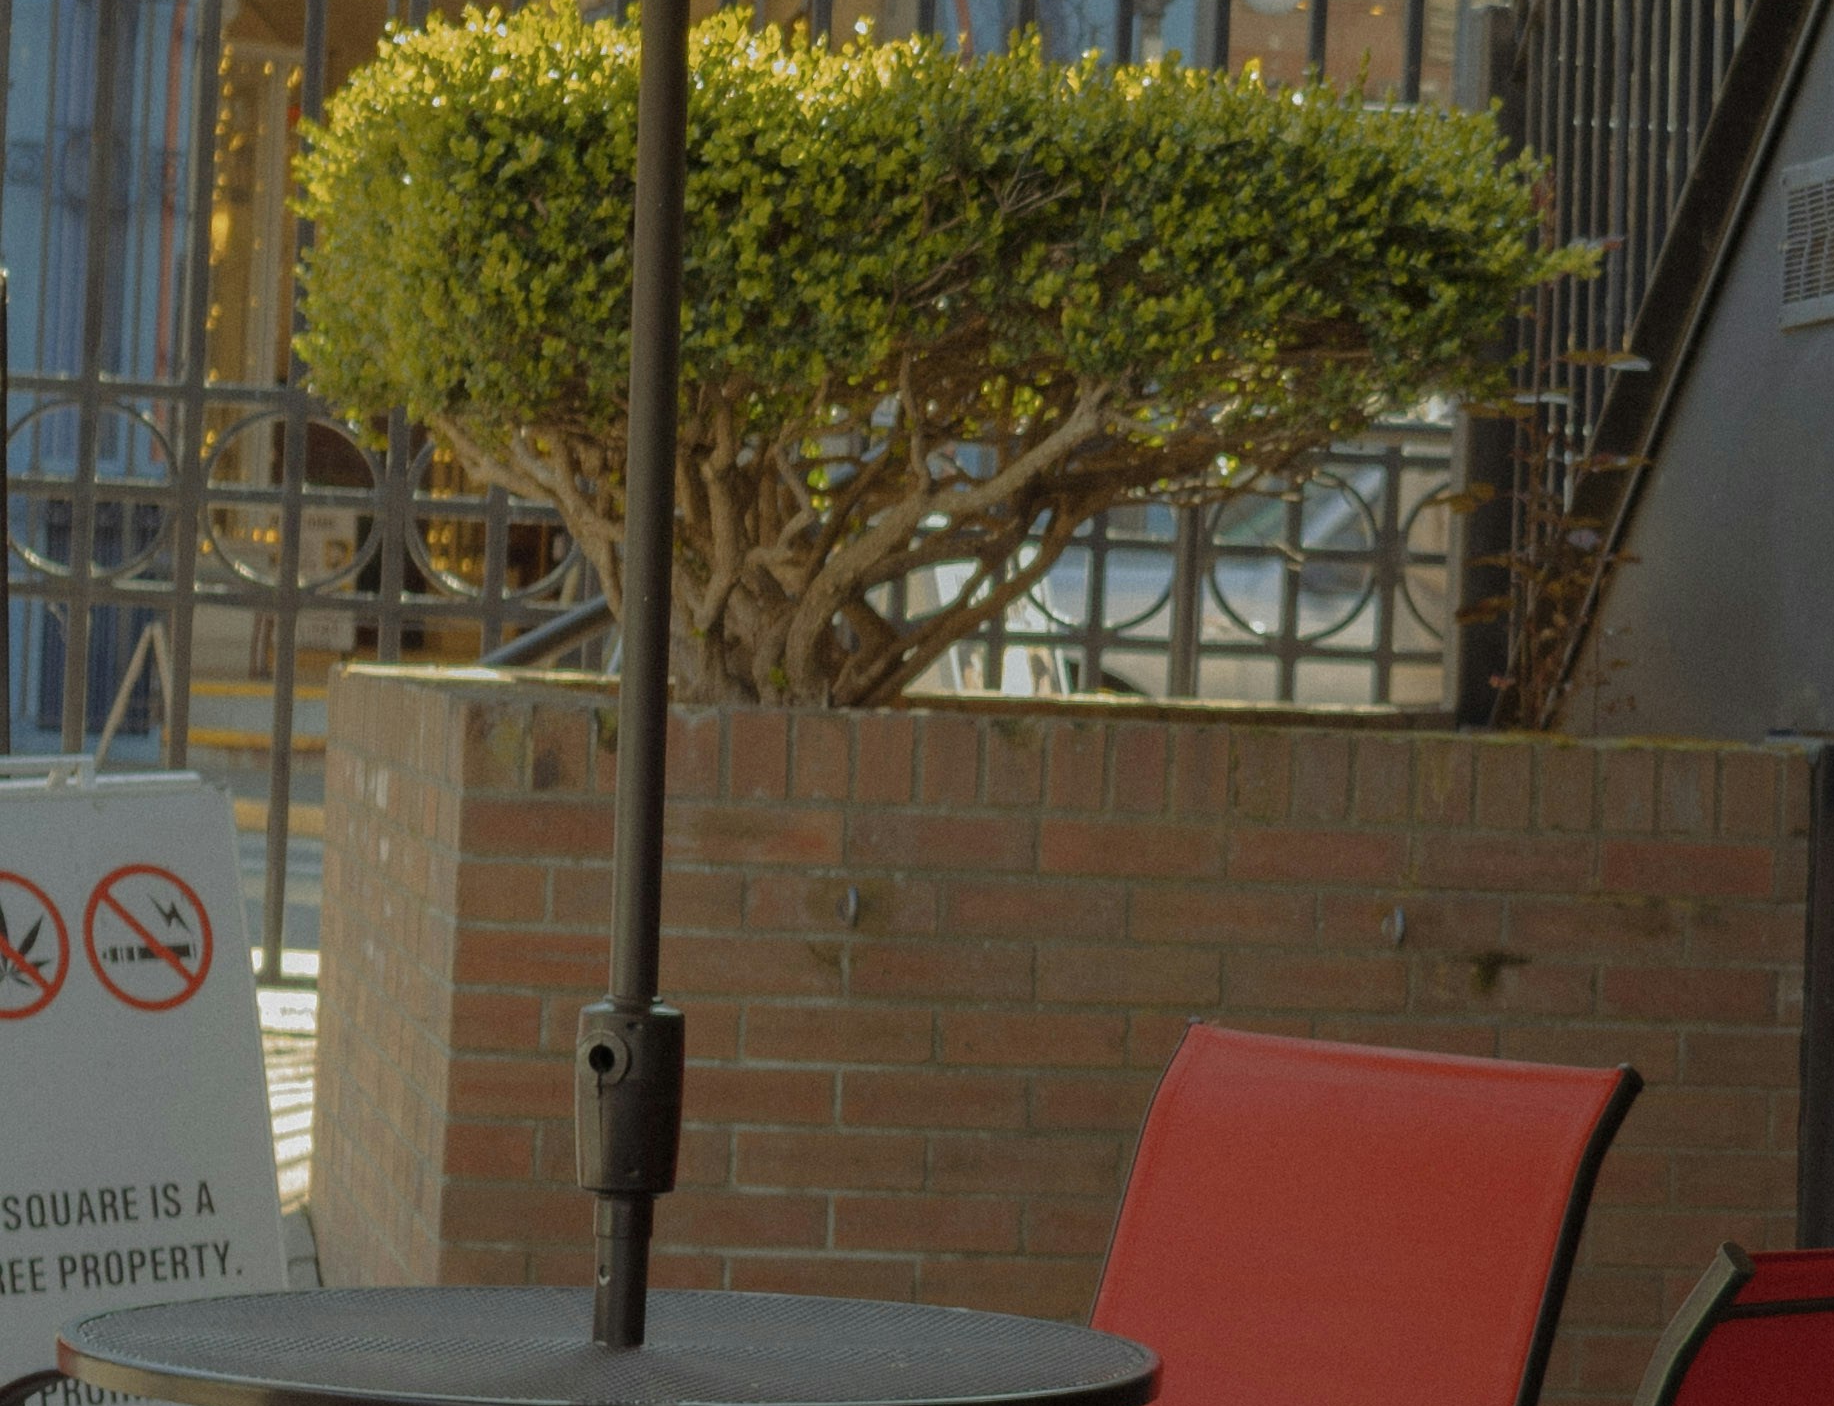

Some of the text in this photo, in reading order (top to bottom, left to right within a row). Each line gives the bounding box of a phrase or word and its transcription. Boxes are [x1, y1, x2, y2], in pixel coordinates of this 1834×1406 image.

[3, 1181, 215, 1231] SQUARE IS A
[58, 1240, 243, 1289] PROPERTY.
